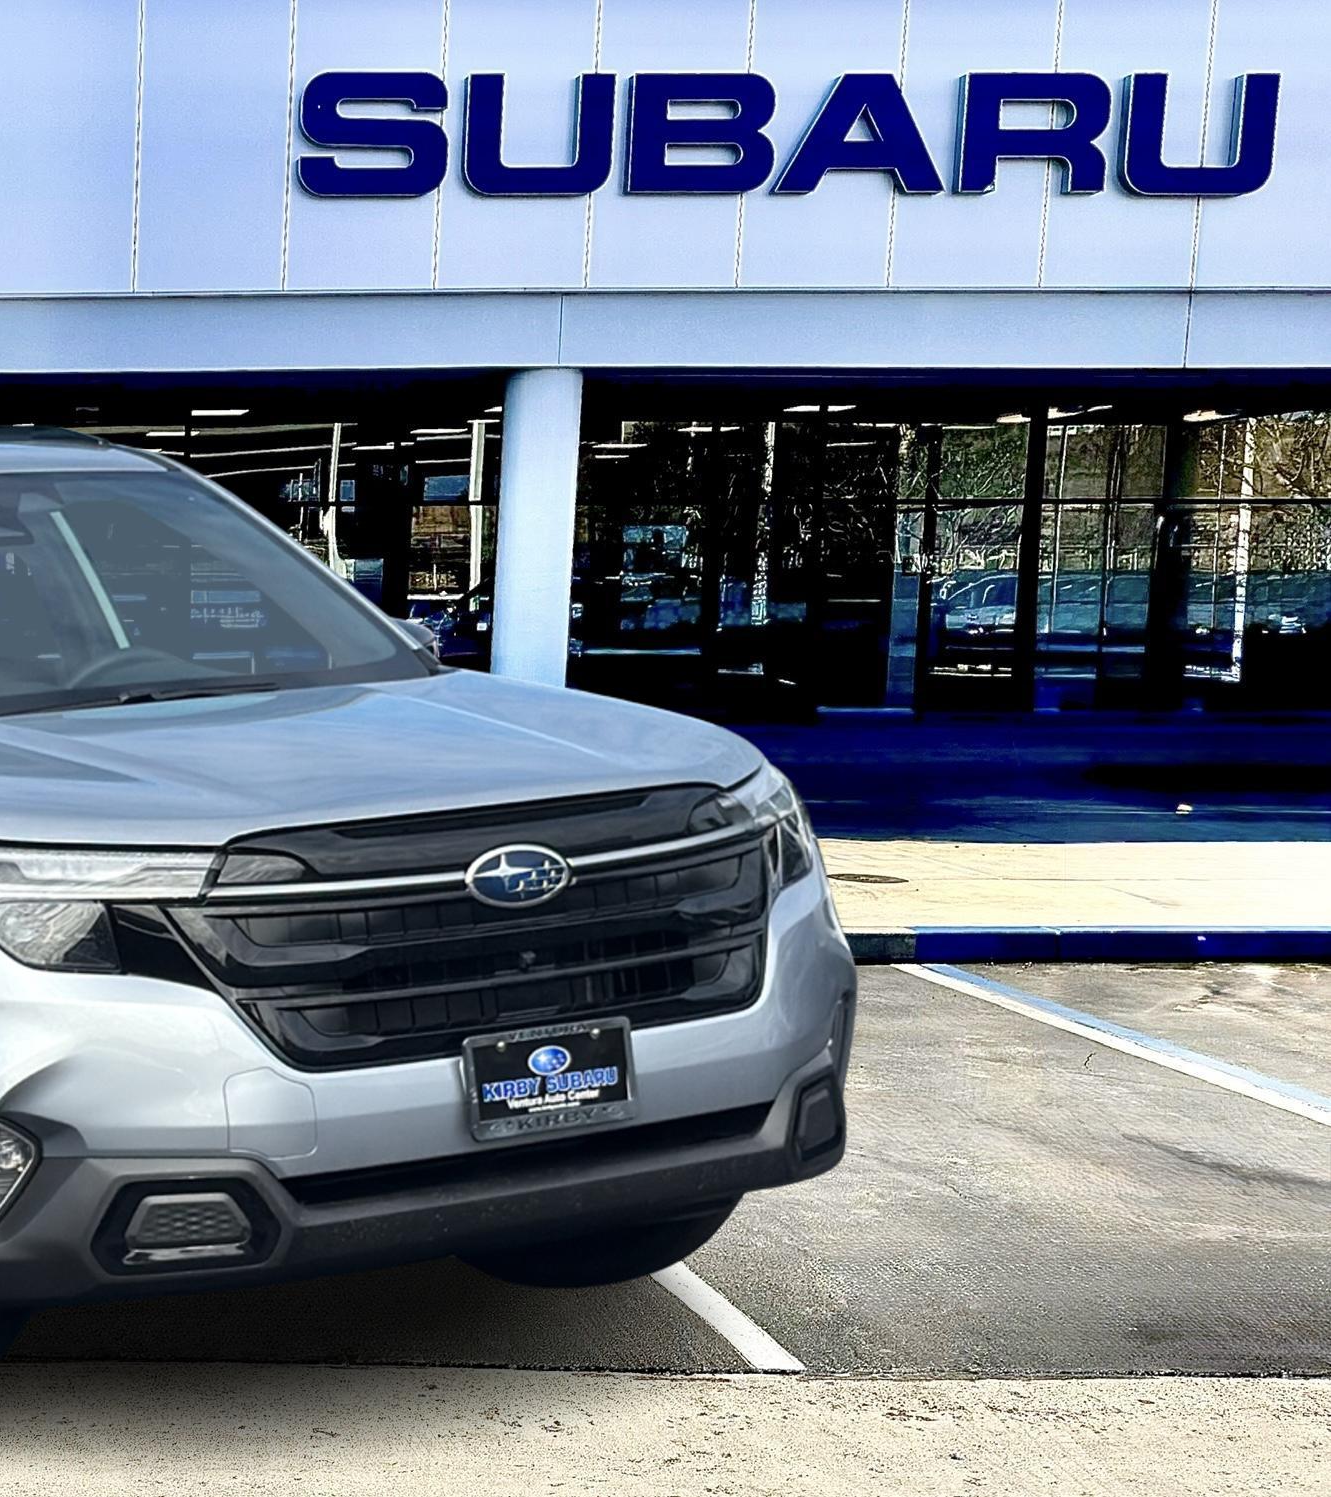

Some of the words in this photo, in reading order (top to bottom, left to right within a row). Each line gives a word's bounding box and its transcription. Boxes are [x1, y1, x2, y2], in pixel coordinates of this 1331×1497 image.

[297, 71, 1281, 198] SUBARU
[482, 1076, 541, 1102] KIRBY
[546, 1066, 618, 1093] SUBARU
[544, 1092, 567, 1104] Auto
[567, 1088, 600, 1102] Center
